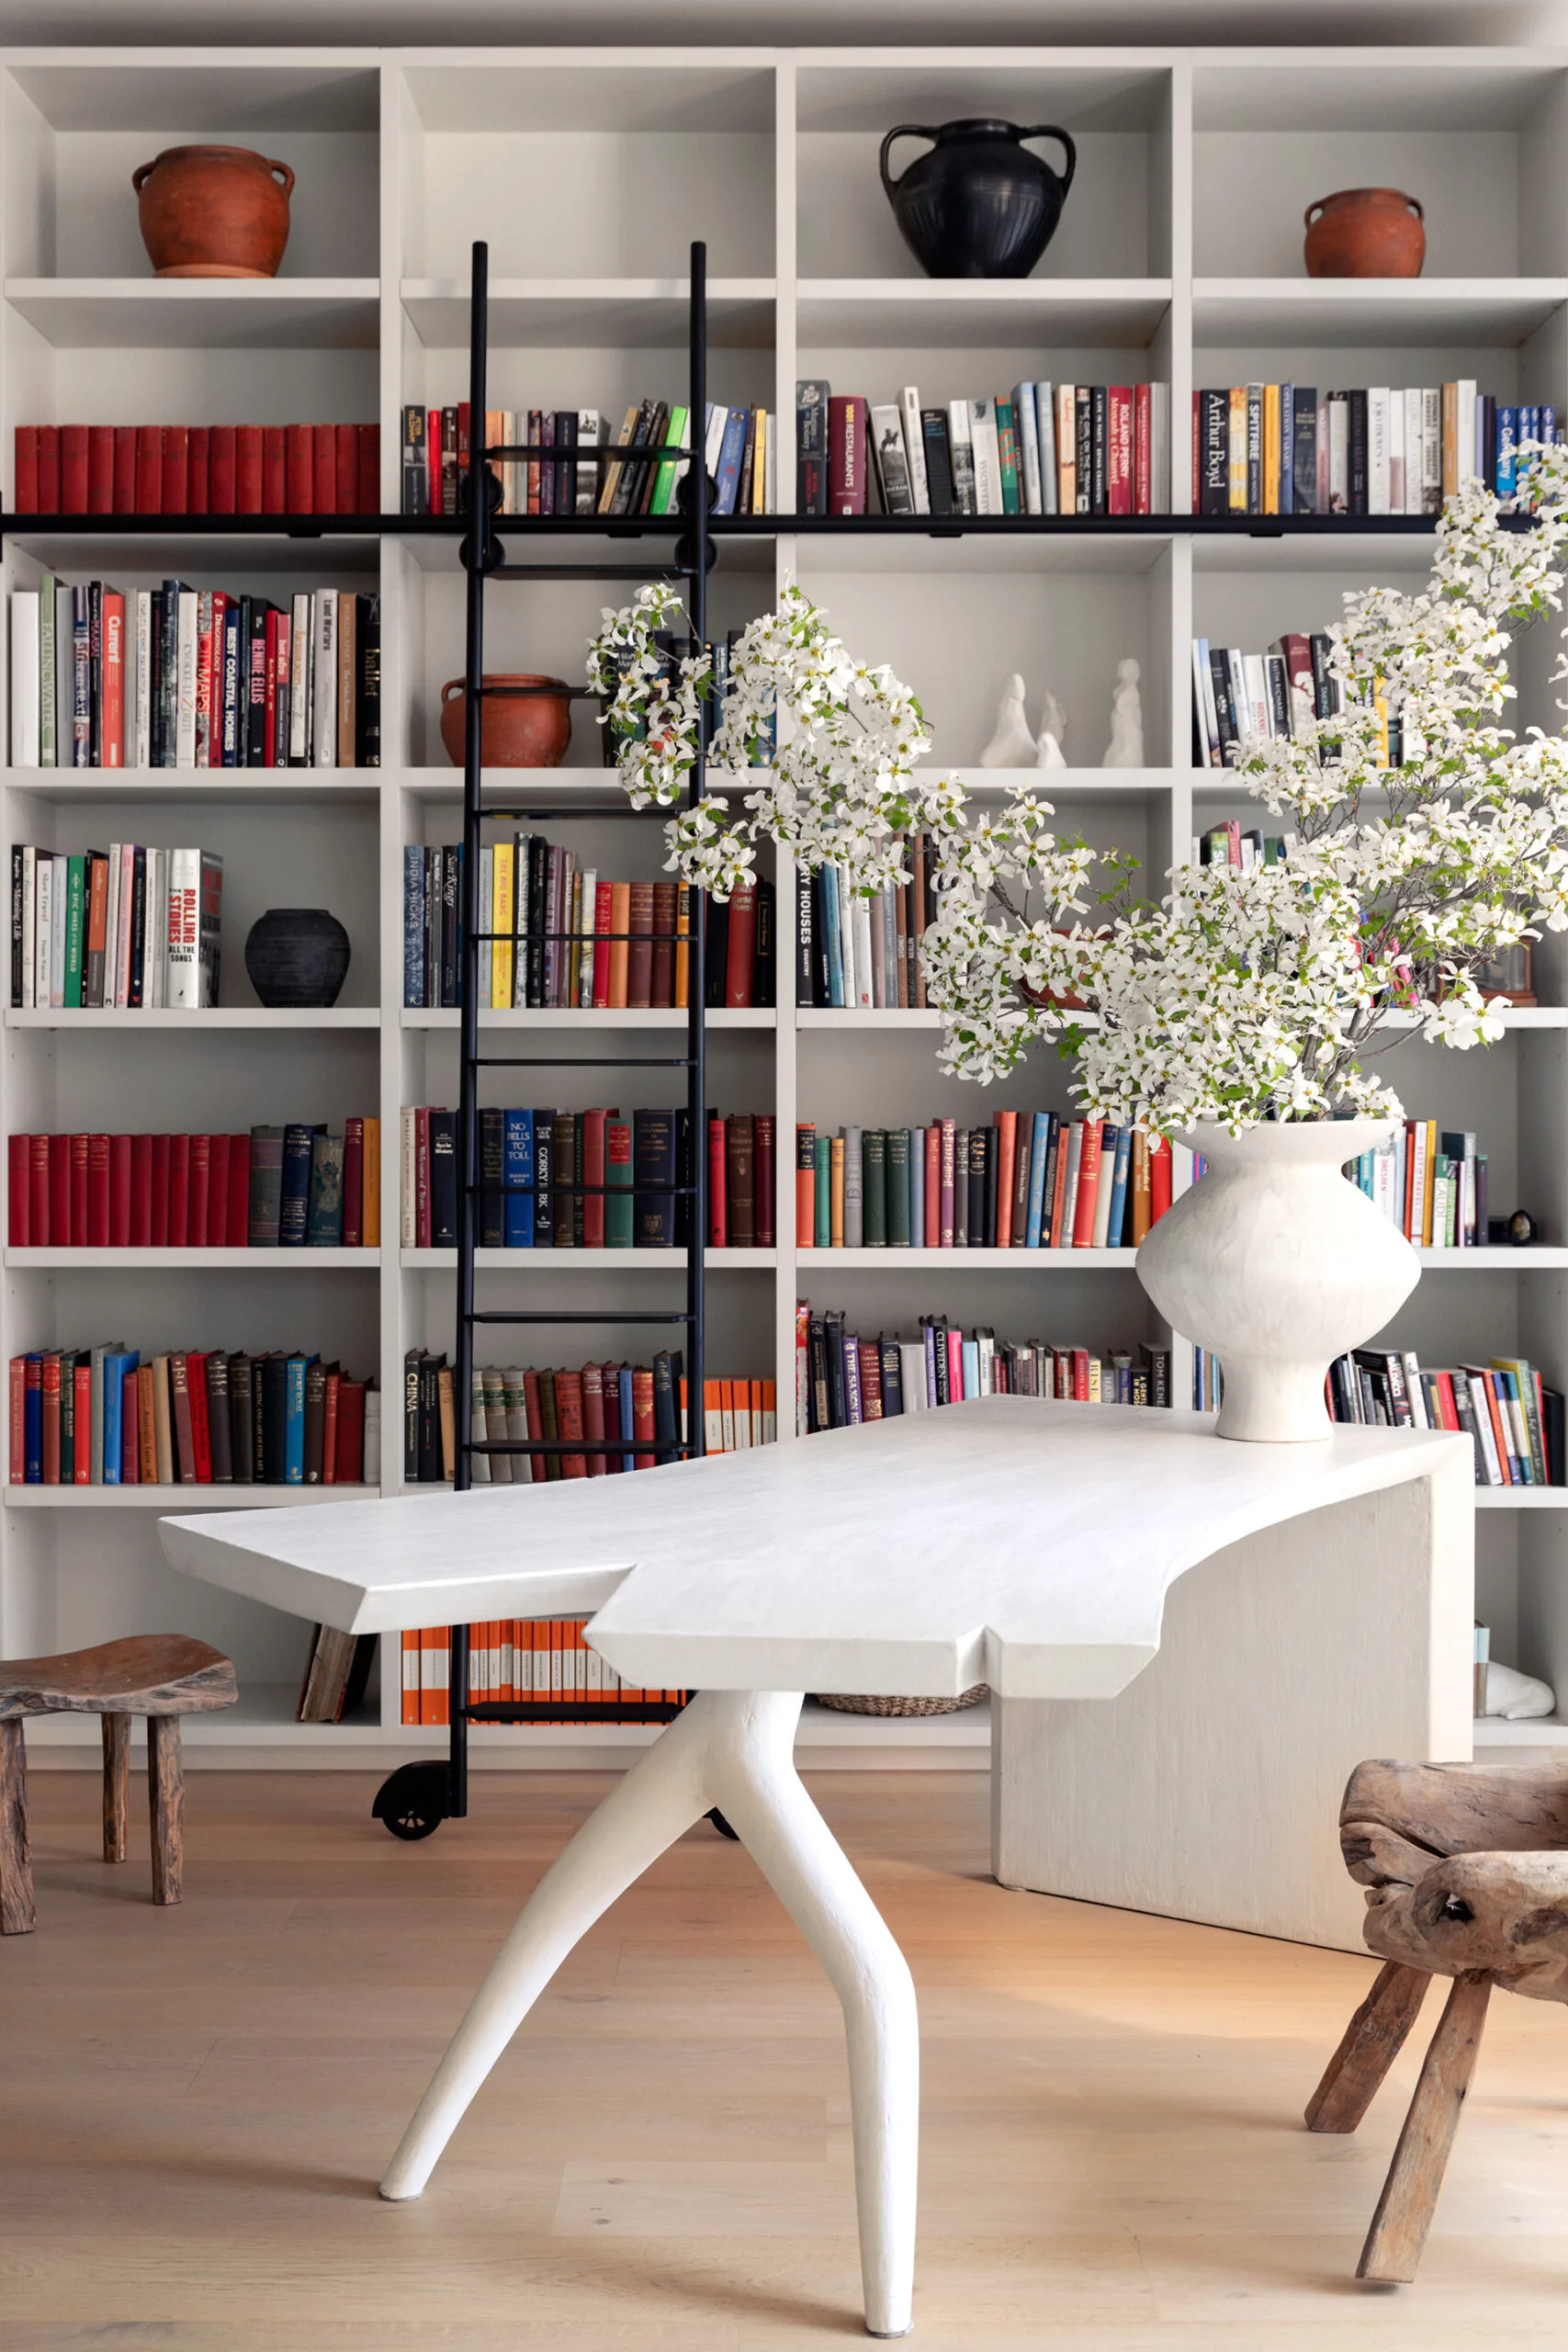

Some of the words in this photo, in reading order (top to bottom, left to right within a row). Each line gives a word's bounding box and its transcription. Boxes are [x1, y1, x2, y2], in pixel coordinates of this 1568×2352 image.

[846, 404, 854, 423] 1001
[1111, 397, 1119, 435] Monash
[1121, 404, 1129, 445] ROLAND
[1209, 394, 1225, 447] Arthur
[1249, 404, 1259, 460] SPITFIRE
[845, 424, 854, 488] RESTAURANTS
[1110, 446, 1118, 484] Chauvel
[1120, 447, 1129, 478] PERRY
[1206, 450, 1224, 488] Boyd
[322, 599, 333, 616] Land
[108, 616, 121, 663] Current
[227, 627, 237, 655] BEST
[278, 639, 288, 654] hot
[322, 618, 333, 650] Warfare
[252, 639, 265, 674] RENNIE
[278, 657, 288, 675] afro
[1272, 660, 1281, 682] KEITH
[41, 622, 53, 728] FALLINGWATER
[225, 658, 236, 708] COASTAL
[365, 649, 380, 698] ballet
[251, 677, 265, 704] ELLIS
[1274, 683, 1284, 720] RICHARDS
[1319, 686, 1330, 714] TAKING
[224, 710, 235, 751] HOMES
[410, 856, 418, 888] INDIA
[446, 854, 457, 874] Sun
[13, 888, 21, 920] Meaning
[443, 875, 457, 908] Kings
[169, 895, 181, 943] STONES
[183, 888, 196, 944] ROLLING
[410, 891, 419, 929] HICKS
[801, 890, 811, 944] HOUSES
[169, 945, 181, 954] ALL
[507, 1132, 530, 1140] BELLS
[511, 1123, 525, 1131] NO
[508, 1151, 530, 1159] TOLL
[513, 1142, 525, 1150] TO
[538, 1148, 548, 1183] GORKY
[1415, 1176, 1424, 1206] TRAVEL
[846, 1352, 856, 1374] THE
[936, 1331, 946, 1378] CLIVEDEN
[1156, 1355, 1165, 1377] TOM
[848, 1375, 858, 1410] SAXON
[1089, 1364, 1100, 1395] RISE
[1133, 1378, 1141, 1387] IN
[1386, 1356, 1402, 1397] BALDACCI
[407, 1374, 418, 1412] CHINA
[1133, 1388, 1141, 1406] MOS
[1156, 1380, 1165, 1407] KENE
